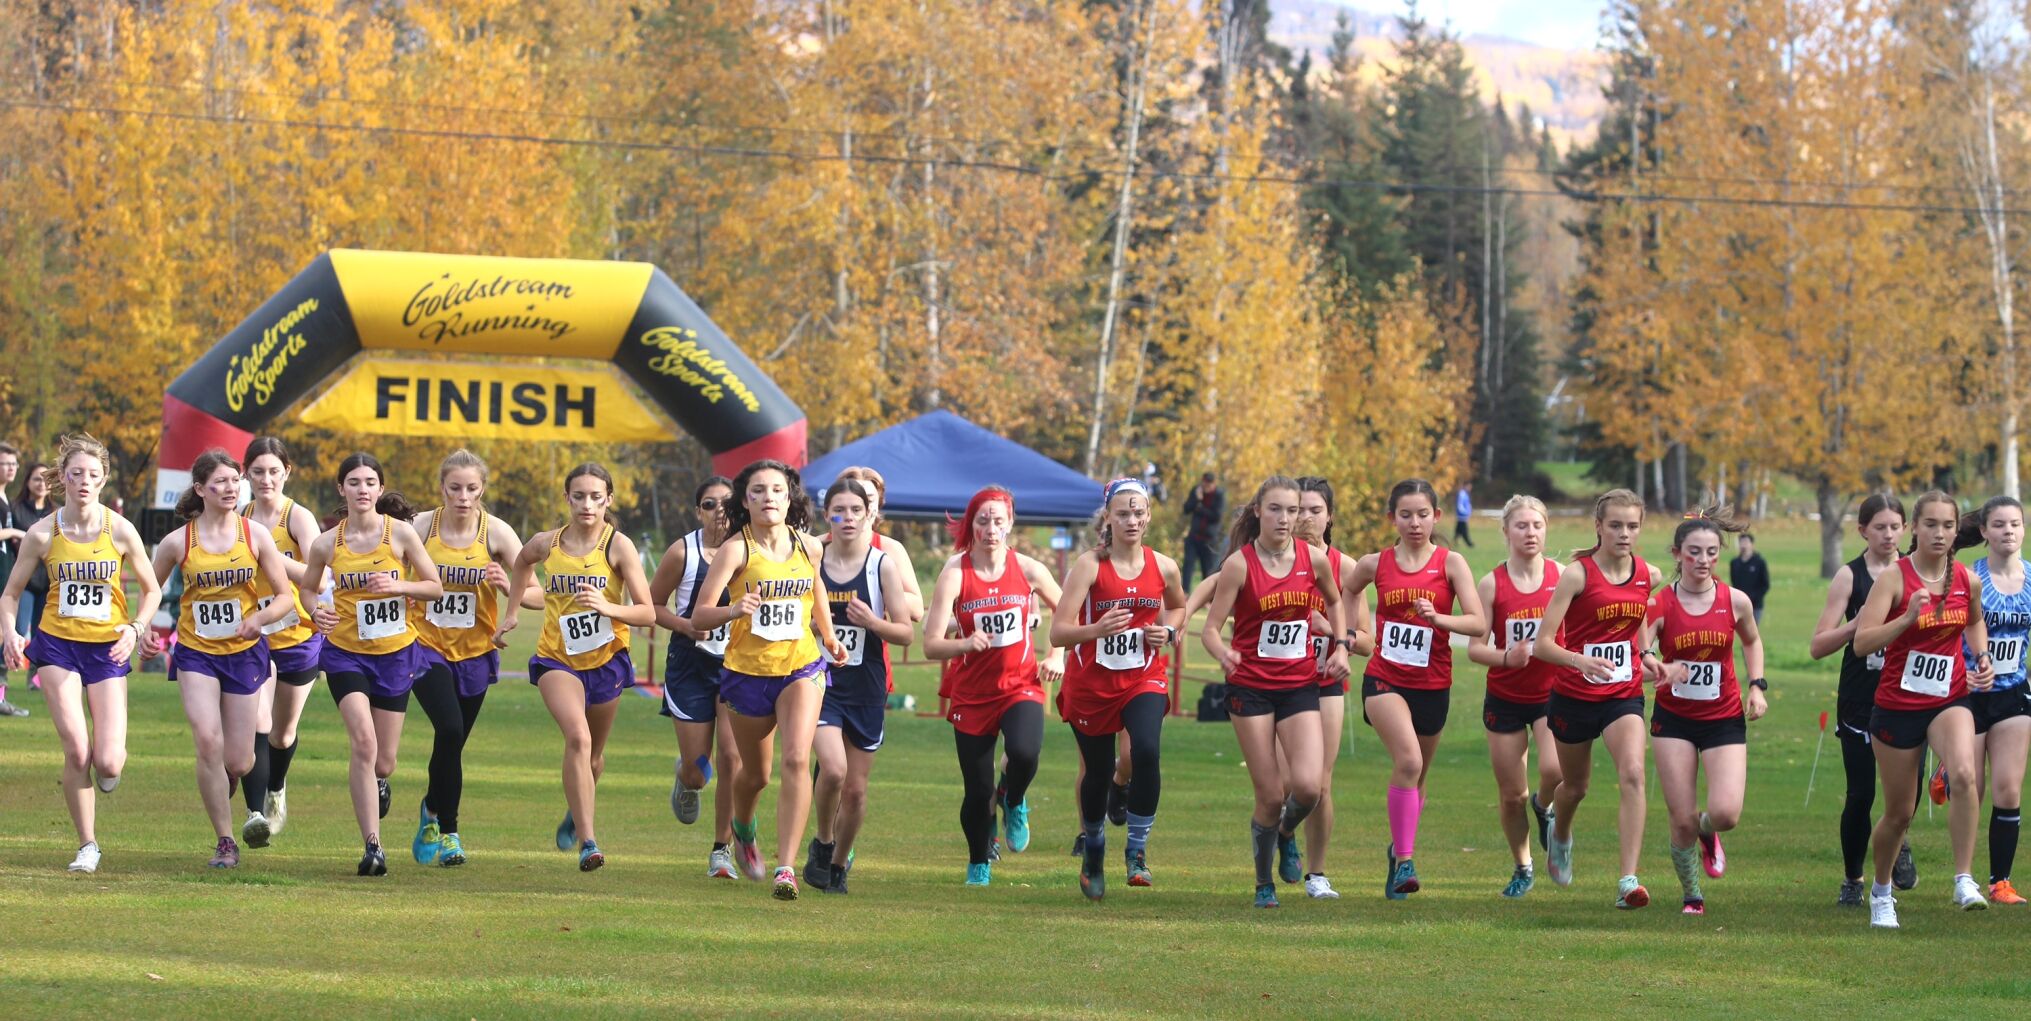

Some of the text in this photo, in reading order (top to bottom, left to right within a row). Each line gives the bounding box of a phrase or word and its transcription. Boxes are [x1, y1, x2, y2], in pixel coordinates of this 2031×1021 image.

[402, 273, 575, 327] Goldstream
[419, 304, 576, 345] Running
[226, 298, 319, 412] Goldstream
[253, 333, 307, 405] Sports
[640, 326, 760, 413] Goldstream
[648, 354, 724, 404] Sports
[375, 376, 597, 428] FINISH
[50, 560, 117, 581] LATHROP
[336, 570, 399, 591] ATHP
[67, 584, 103, 606] 835
[433, 595, 468, 615] 843
[961, 598, 998, 612] NORTH
[1260, 591, 1309, 611] WEST VALLEY
[1384, 589, 1405, 607] WEST
[199, 602, 235, 625] 849
[364, 600, 400, 626] 848
[759, 603, 795, 627] 856
[1597, 602, 1646, 621] WEST VALLEY
[566, 612, 601, 640] 857
[981, 612, 1016, 635] 892
[1267, 623, 1302, 646] 937
[822, 629, 858, 651] 23
[1104, 631, 1138, 656] 884
[1388, 625, 1425, 651] 944
[1674, 630, 1728, 650] WEST VALLEY
[1911, 655, 1948, 681] 908
